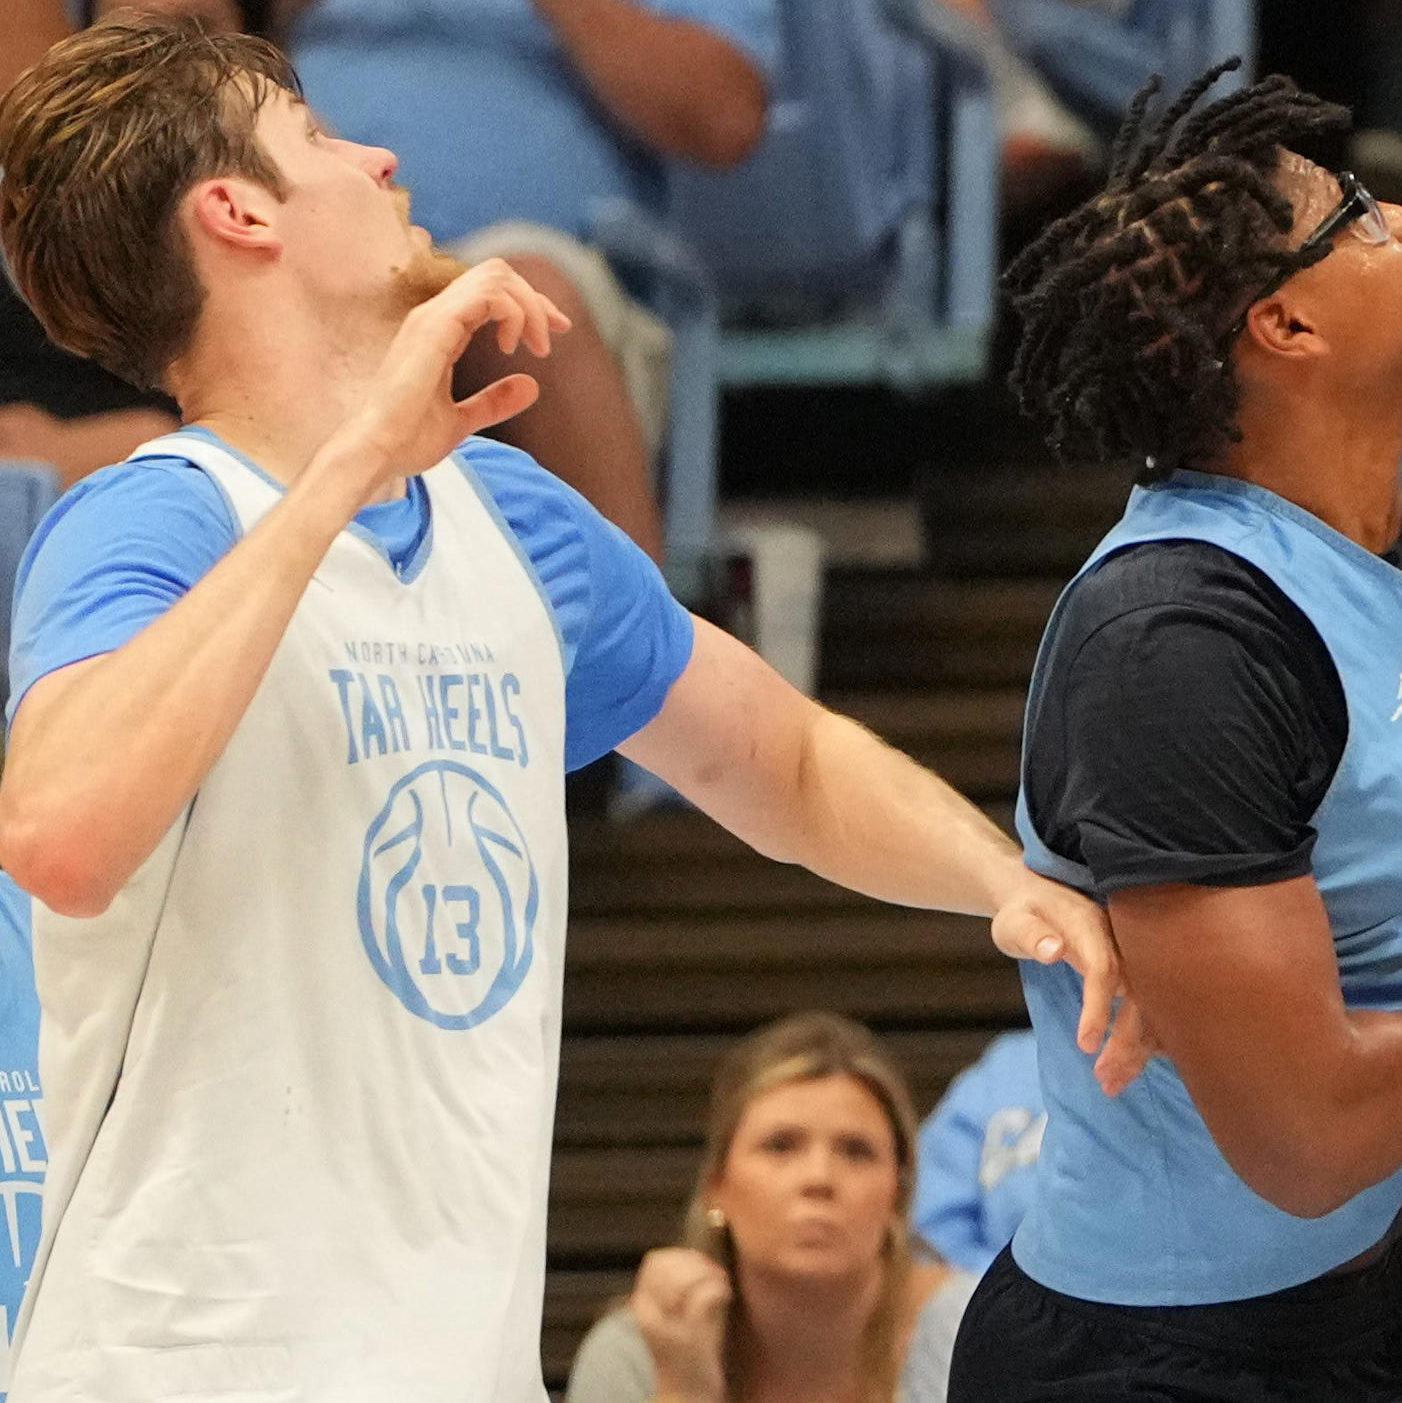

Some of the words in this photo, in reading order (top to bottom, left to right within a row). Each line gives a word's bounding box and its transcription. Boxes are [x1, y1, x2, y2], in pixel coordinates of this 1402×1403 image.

[344, 641, 408, 665] NORTH
[329, 668, 411, 765] TAR
[416, 672, 529, 769] HEELS
[419, 884, 481, 975] 13
